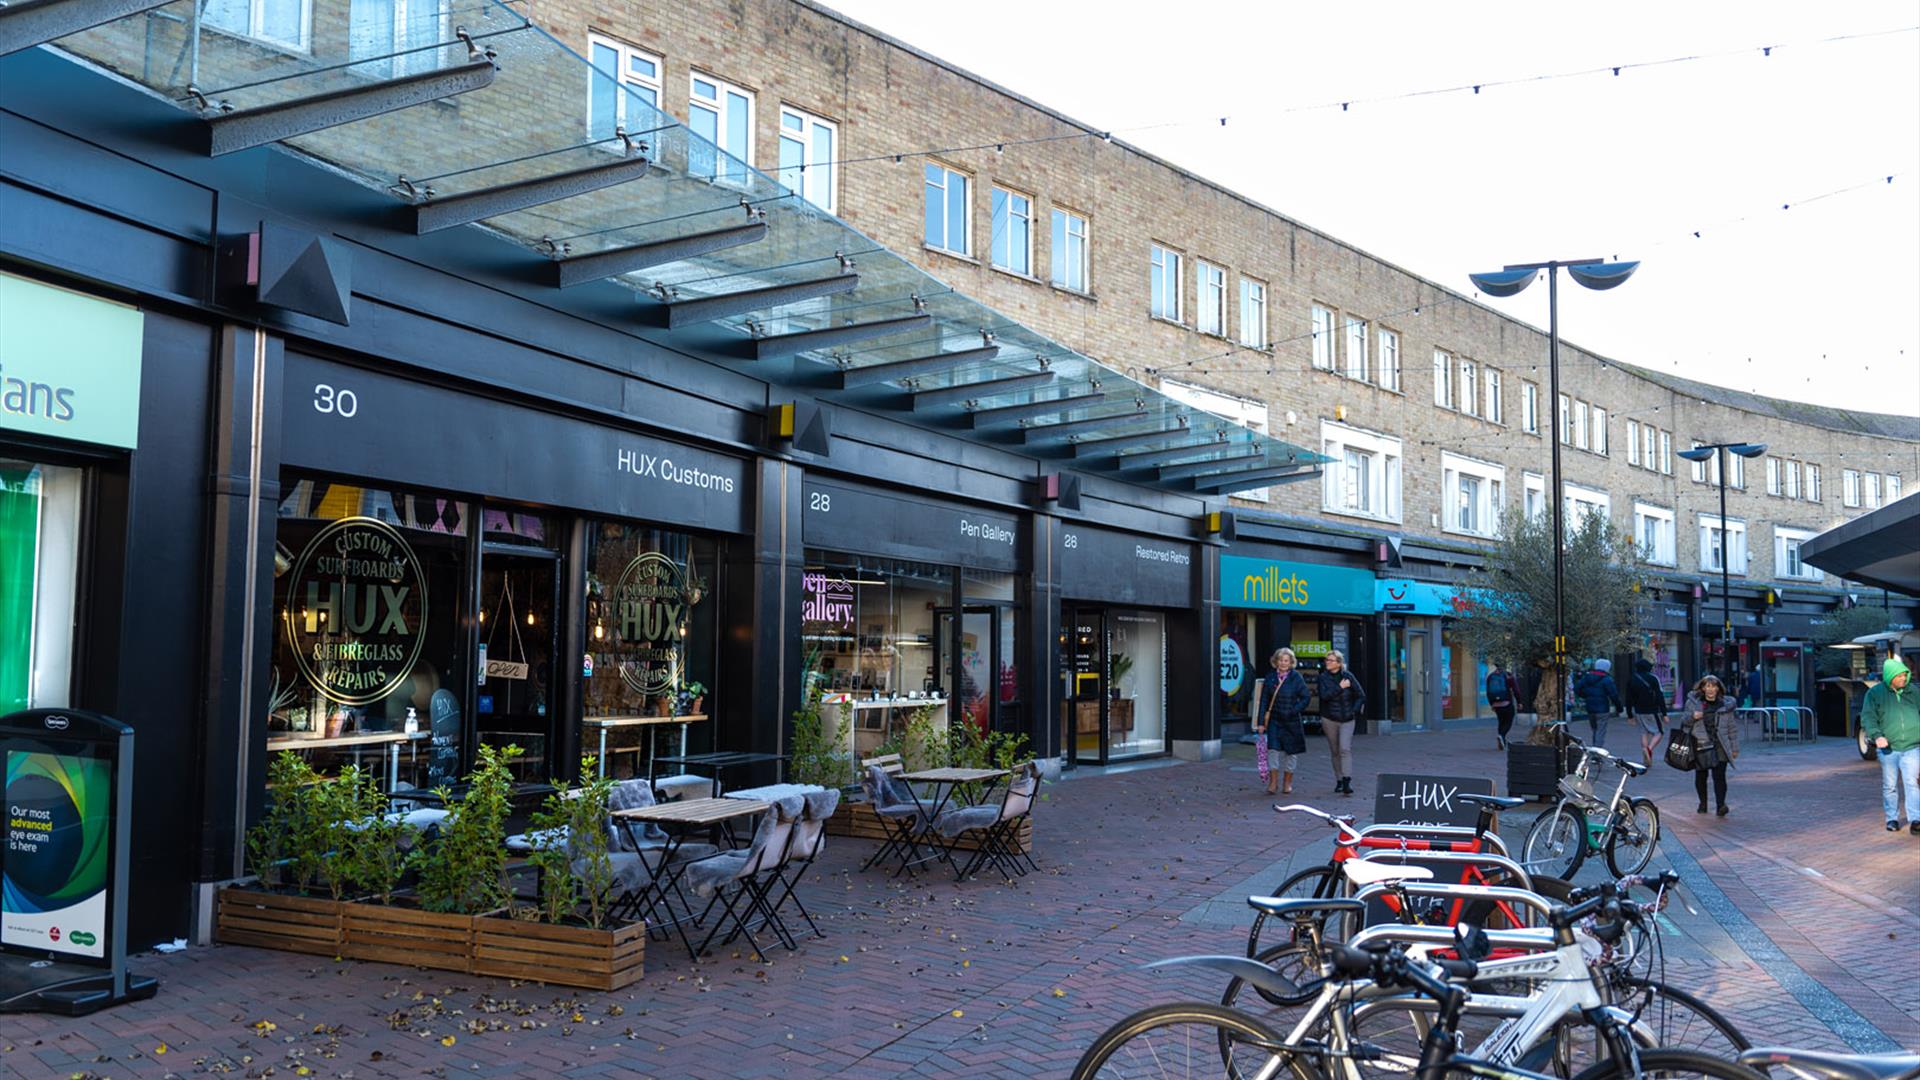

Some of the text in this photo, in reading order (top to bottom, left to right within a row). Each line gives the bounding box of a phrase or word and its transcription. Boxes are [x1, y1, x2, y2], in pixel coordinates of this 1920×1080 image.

[314, 384, 357, 418] 30
[618, 448, 734, 493] HUX Customs
[811, 492, 830, 512] 28
[960, 520, 1016, 545] Pen Gallery
[1064, 534, 1078, 549] 26
[335, 532, 392, 559] CUSTOM
[1136, 545, 1189, 565] Restored Retro
[317, 556, 405, 579] SURFBOARDS
[637, 563, 672, 584] CUSTOM
[627, 583, 679, 599] SURFBOARDS
[1243, 566, 1309, 605] millets
[305, 581, 410, 635] HUX
[620, 602, 682, 641] HUX
[313, 643, 403, 661] & FIBREGLASS
[1290, 642, 1327, 653] OFFERS
[327, 665, 386, 690] REPAIRS
[634, 664, 668, 684] REPAIRS
[11, 806, 51, 820] Our most
[10, 818, 53, 832] advanced
[10, 830, 50, 843] eye exam
[10, 839, 38, 853] is here
